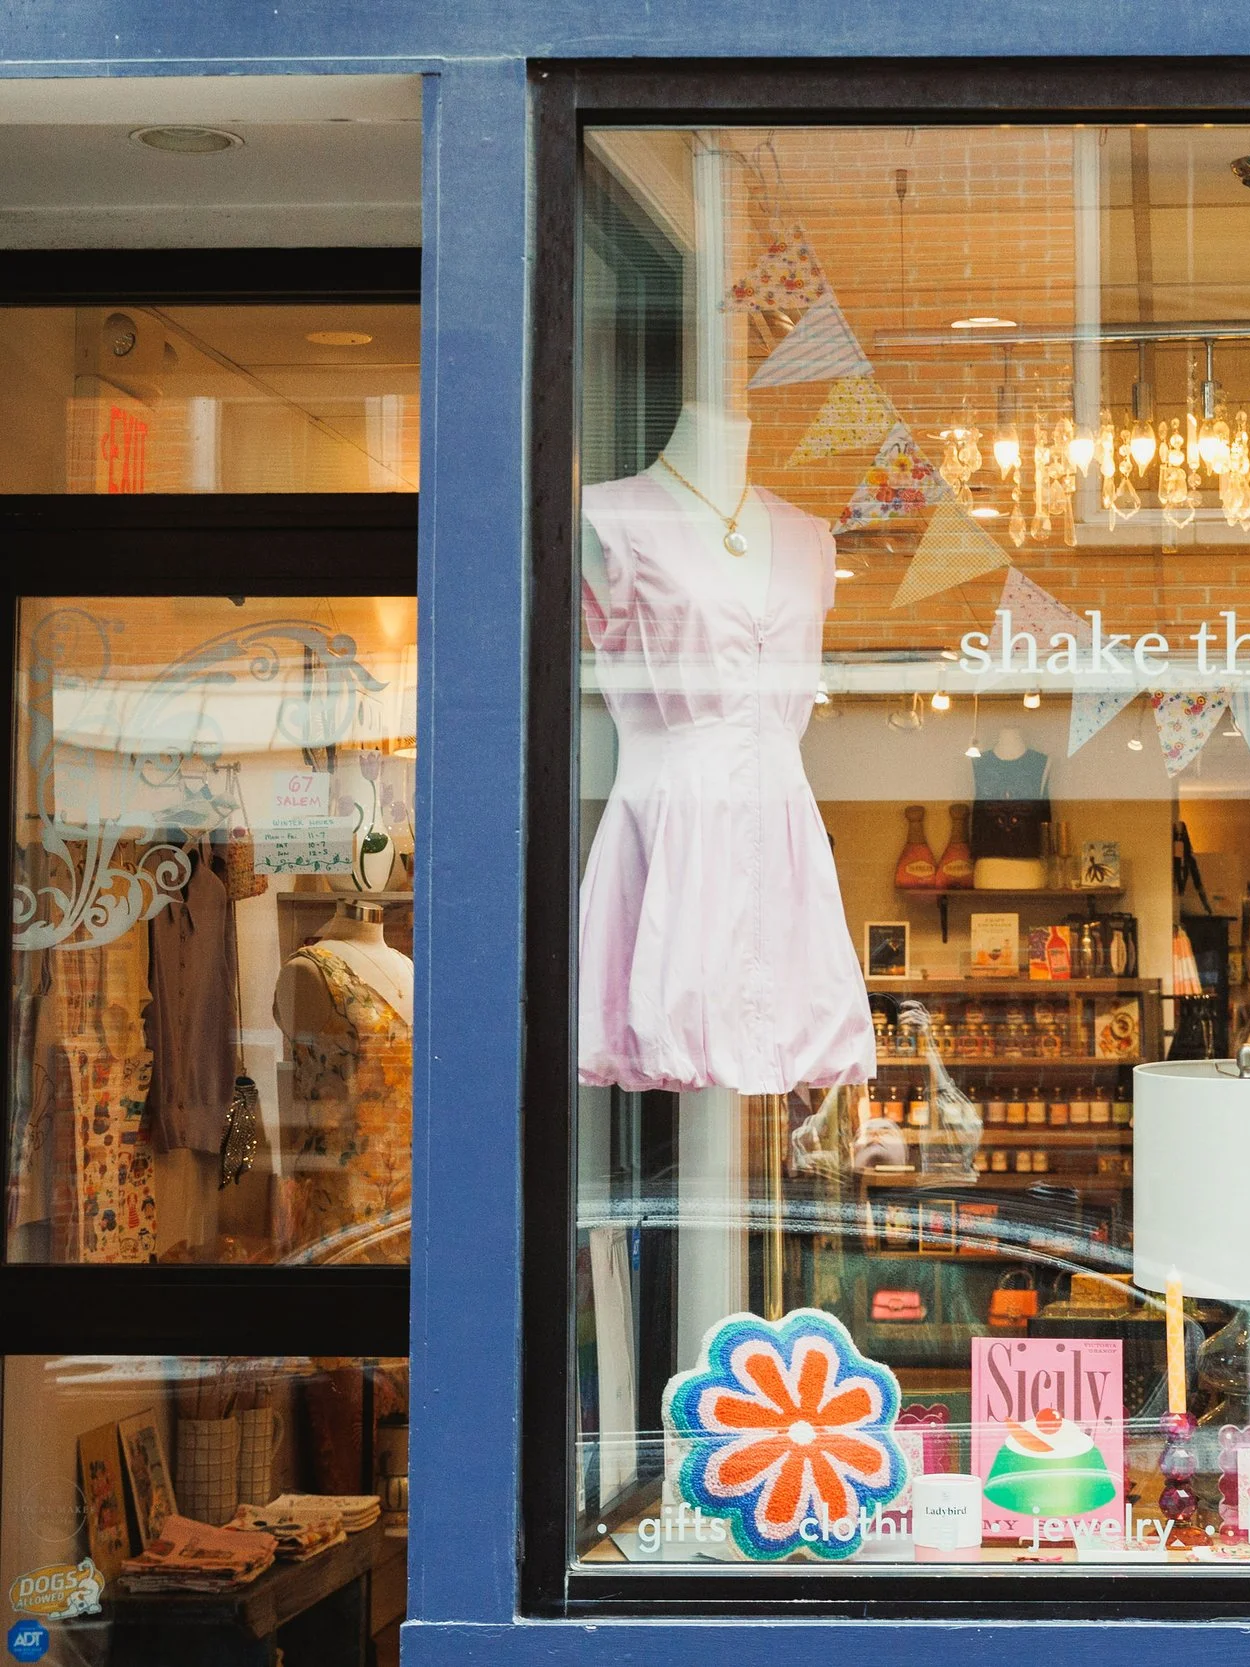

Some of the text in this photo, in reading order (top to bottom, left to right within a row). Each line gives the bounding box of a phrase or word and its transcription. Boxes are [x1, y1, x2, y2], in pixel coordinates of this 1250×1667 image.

[959, 610, 1170, 676] shake
[288, 775, 313, 793] 67
[275, 796, 321, 808] SALEM
[272, 819, 334, 827] WINTER HOURS
[925, 1506, 967, 1517] Ladybird
[637, 1502, 727, 1553] gifts
[799, 1502, 940, 1546] clothi
[1028, 1503, 1175, 1553] jewelry
[19, 1570, 79, 1598] DOGS
[16, 1592, 65, 1610] ALLOWED
[13, 1631, 44, 1647] ADT
